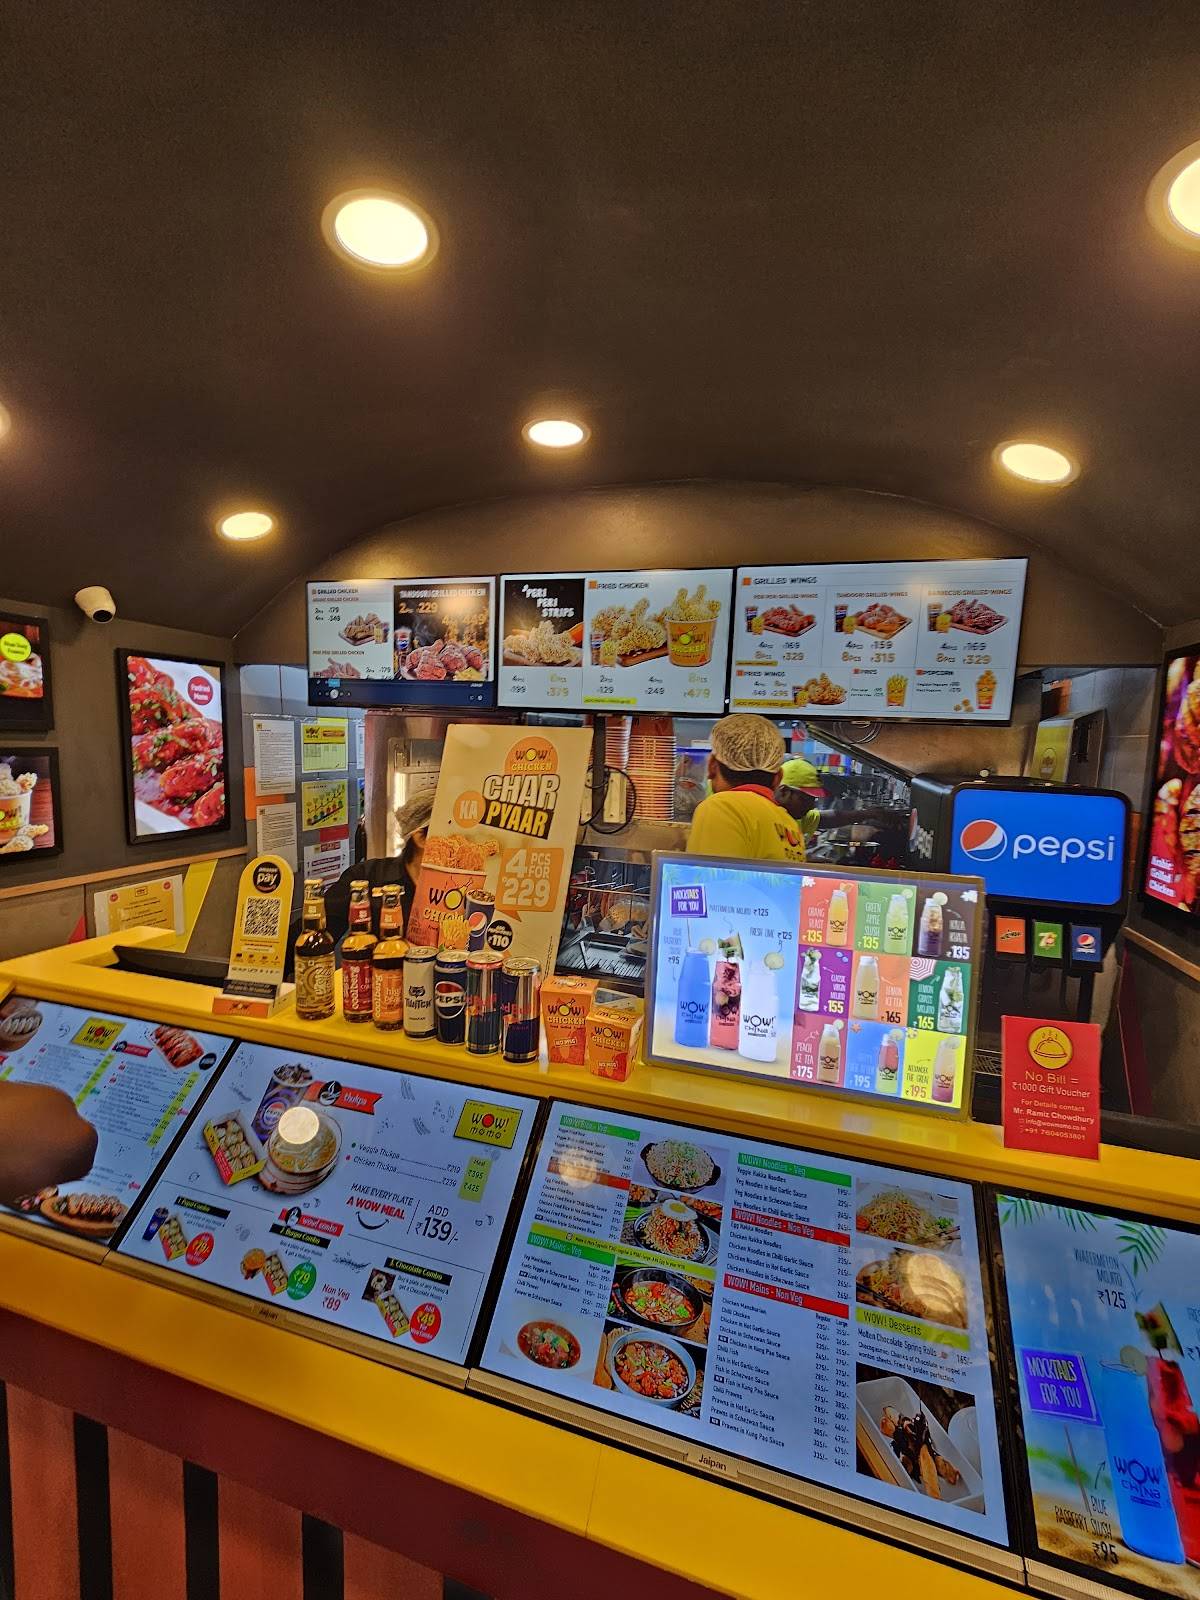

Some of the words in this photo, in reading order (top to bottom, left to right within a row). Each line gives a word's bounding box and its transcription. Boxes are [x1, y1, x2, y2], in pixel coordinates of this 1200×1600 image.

[541, 607, 574, 618] STRIPS
[511, 763, 553, 772] CHICKEN
[482, 773, 561, 810] CHAR
[459, 800, 479, 821] KA
[486, 803, 549, 837] PYAAR
[1013, 834, 1115, 864] pepsi
[505, 849, 528, 879] 4
[530, 852, 551, 865] PCS
[528, 865, 550, 880] FOR
[256, 871, 278, 885] pay
[678, 901, 688, 911] FOR
[688, 901, 699, 911] YOU
[796, 1041, 813, 1053] PEACH
[1025, 1070, 1044, 1082] No
[1047, 1073, 1067, 1085] Bill
[1012, 1081, 1038, 1092] ₹1000
[1039, 1084, 1055, 1095] Gift
[1055, 1086, 1091, 1098] Voucher
[1021, 1098, 1033, 1106] For
[1034, 1100, 1058, 1109] Details
[1058, 1104, 1085, 1112] contact
[471, 1112, 511, 1130] WOW!
[1013, 1107, 1025, 1115] Mr.
[1026, 1108, 1050, 1118] Ramiz
[1051, 1111, 1095, 1125] Chowdhury
[359, 1143, 379, 1155] Veggie
[380, 1146, 401, 1161] Thukpa
[353, 1156, 376, 1168] Chicken
[377, 1160, 398, 1174] Thukpa
[467, 1169, 484, 1180] ₹395
[351, 1183, 370, 1195] MAKE
[370, 1186, 393, 1201] EVERY
[393, 1193, 414, 1207] PLATE
[463, 1181, 480, 1193] ₹425
[346, 1195, 354, 1206] A
[355, 1197, 382, 1213] WOW
[381, 1204, 406, 1220] MEAL
[427, 1204, 449, 1218] ADD
[1073, 1248, 1120, 1268] WATERMELON
[1096, 1268, 1123, 1287] MOJITO
[321, 1283, 337, 1295] Non
[337, 1287, 351, 1301] Veg
[727, 1275, 749, 1290] WOW!
[749, 1281, 770, 1296] Mains
[775, 1287, 790, 1300] Non
[790, 1291, 804, 1305] Veg
[322, 1296, 341, 1312] ₹89
[1097, 1289, 1127, 1310] ₹125
[863, 1310, 887, 1327] WOW!
[888, 1317, 922, 1336] Desserts
[857, 1327, 876, 1341] Molten
[876, 1333, 903, 1349] Chocolate
[904, 1340, 923, 1355] Spring
[922, 1345, 937, 1357] Rolls
[1025, 1356, 1078, 1382] MOCKTAILS
[1040, 1383, 1060, 1406] FOR
[1059, 1385, 1082, 1409] YOU
[699, 1453, 728, 1472] Jaipan
[1091, 1541, 1119, 1565] ₹95
